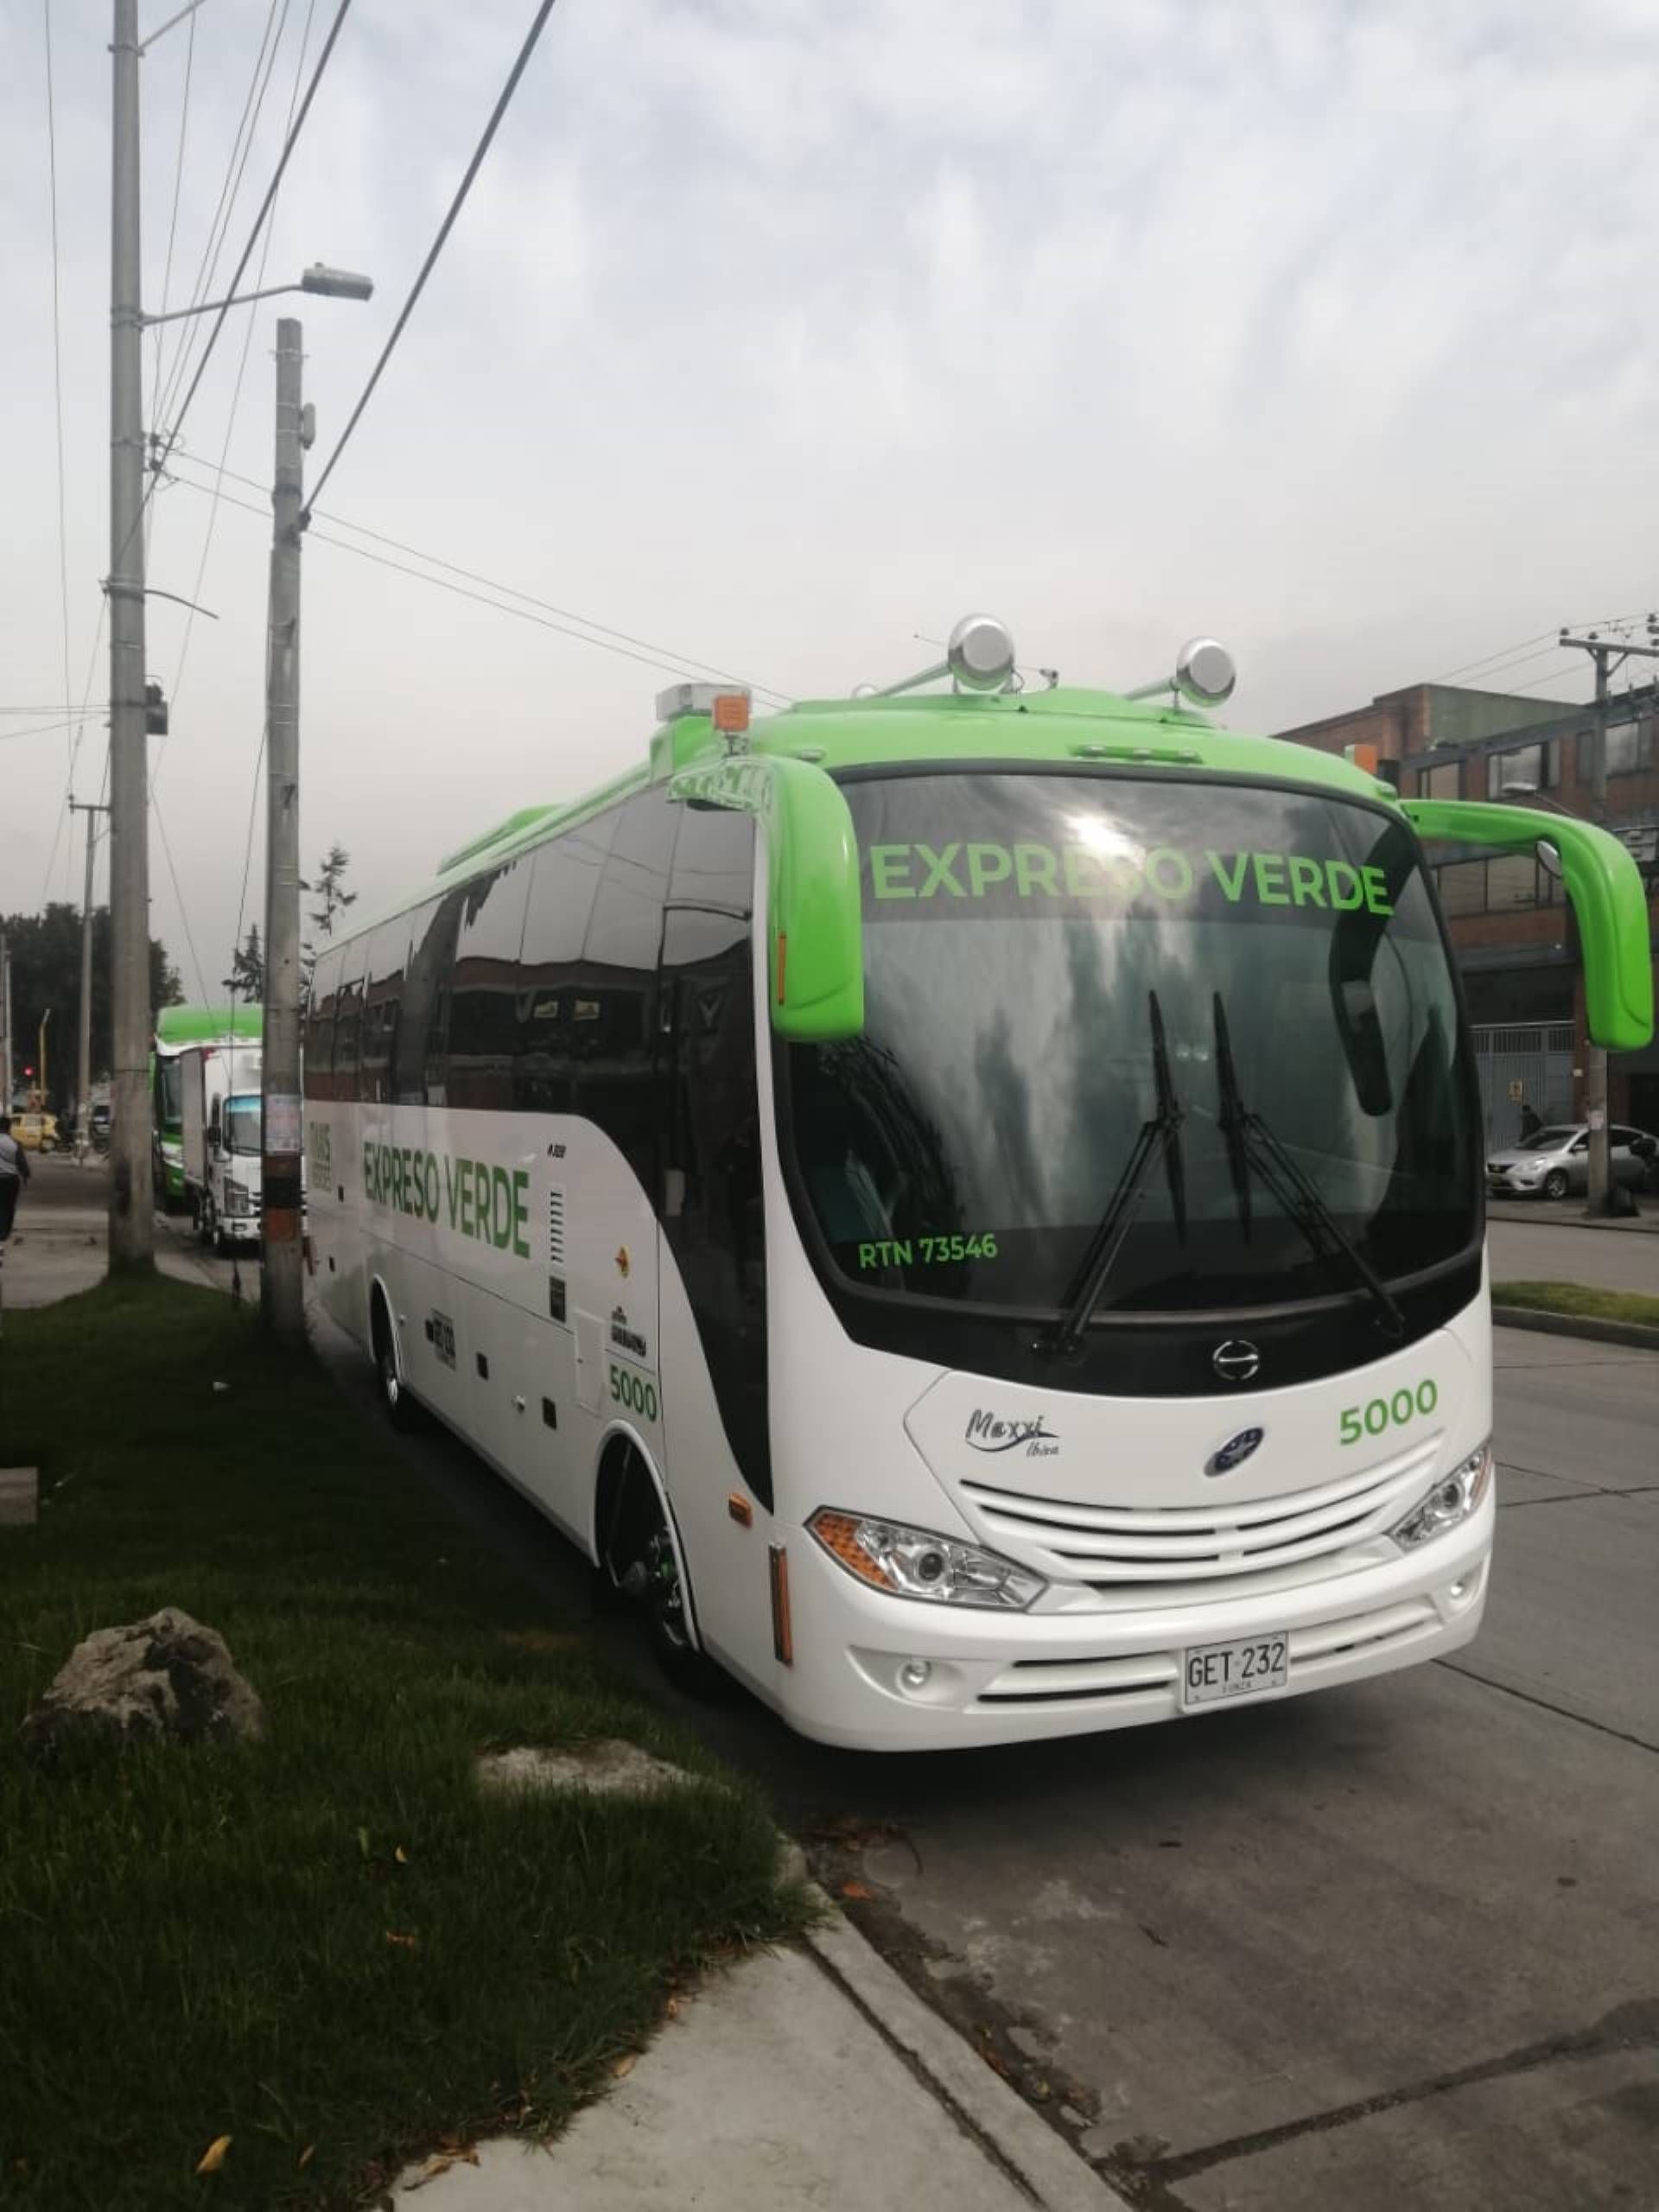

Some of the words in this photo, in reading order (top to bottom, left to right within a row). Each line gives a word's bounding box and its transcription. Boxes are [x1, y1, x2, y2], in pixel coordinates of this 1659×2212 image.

[869, 842, 1193, 901] EXPRESO
[1207, 851, 1395, 916] VERDE
[364, 1141, 439, 1224] EXPRESO
[445, 1158, 531, 1259] VERDE
[859, 1240, 914, 1268] RTN
[918, 1232, 998, 1264] 73546
[609, 1363, 658, 1423] 5000
[1339, 1380, 1439, 1445] 5000
[965, 1408, 1046, 1440] Maxxi
[1188, 1649, 1233, 1688] GET
[1241, 1642, 1286, 1679] 232
